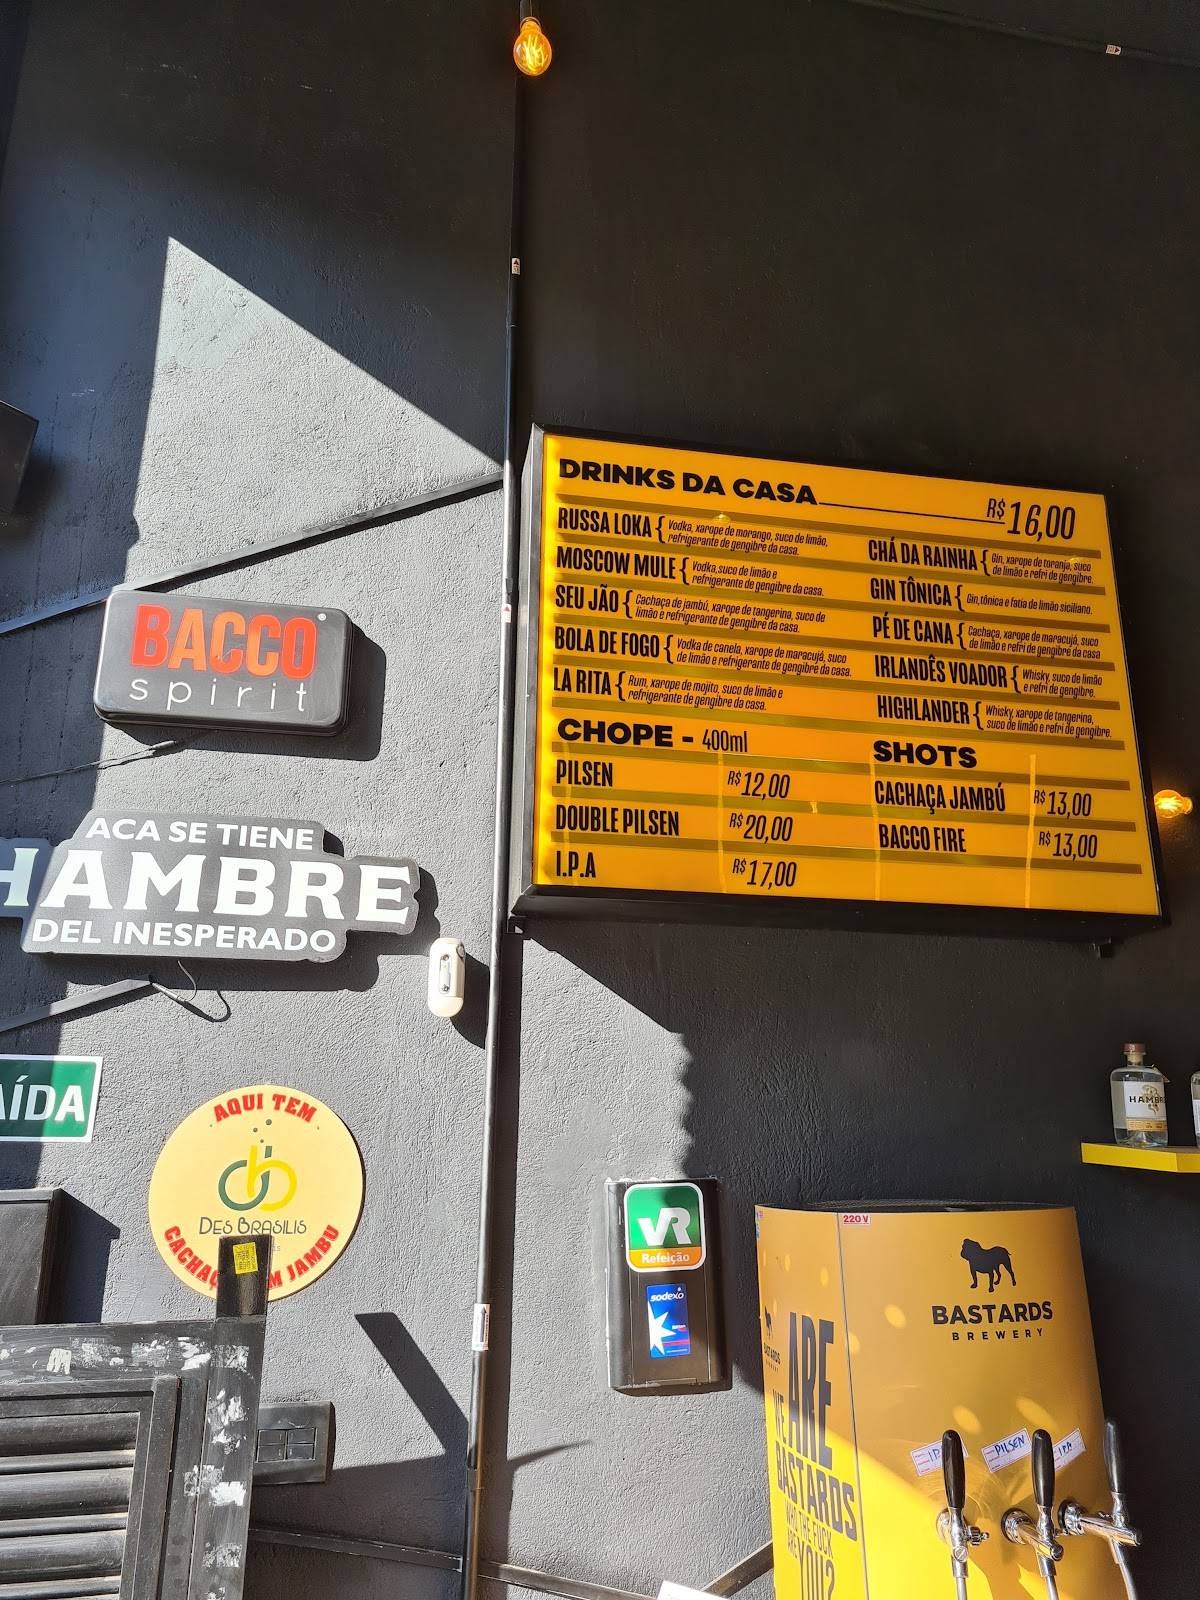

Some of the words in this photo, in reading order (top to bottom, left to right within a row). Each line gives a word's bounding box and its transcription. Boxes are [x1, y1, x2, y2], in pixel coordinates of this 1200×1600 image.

[559, 458, 675, 490] DRINKS
[682, 471, 726, 496] DA
[732, 478, 818, 506] CASA
[557, 507, 611, 534] RUSSA
[614, 512, 652, 538] LOKA
[668, 519, 692, 532] Vodka,
[694, 524, 724, 538] xarope
[724, 525, 735, 537] de
[735, 528, 773, 542] morango,
[774, 532, 794, 543] suco
[794, 532, 805, 544] de
[805, 533, 827, 546] limão,
[667, 532, 719, 548] refrigerante
[730, 540, 767, 554] gengibre
[778, 545, 798, 555] casa.
[868, 536, 898, 563] CHÁ
[900, 542, 921, 566] DA
[922, 544, 978, 571] RAINHA
[556, 545, 631, 575] MOSCOW
[633, 553, 676, 580] MULE
[749, 566, 772, 579] limão
[991, 552, 1005, 565] Gin,
[1005, 556, 1032, 568] xarope
[1043, 559, 1072, 572] toranja,
[1073, 562, 1092, 572] suco
[1003, 565, 1023, 578] limão
[1029, 568, 1048, 580] refri
[1058, 570, 1092, 586] gengibre.
[555, 584, 585, 610] SEU
[587, 583, 619, 613] JÃO
[691, 573, 744, 589] refrigerante
[754, 581, 792, 595] gengibre
[803, 586, 823, 596] casa.
[870, 577, 896, 601] GIN
[898, 575, 952, 607] TÔNICA
[635, 593, 671, 609] Cachaça
[681, 599, 709, 611] jambú,
[711, 603, 741, 615] xarope
[752, 606, 792, 620] tangerina,
[795, 611, 815, 622] suco
[635, 606, 658, 619] limão
[665, 609, 718, 626] refrigerante
[729, 613, 767, 632] gengibre
[778, 622, 799, 633] casa.
[1010, 596, 1028, 609] fatia
[1038, 599, 1059, 612] limão
[1060, 602, 1091, 615] siciliano.
[130, 604, 318, 680] BACCO
[554, 625, 595, 653] BOLA
[598, 629, 618, 655] DE
[621, 631, 660, 659] FOGO
[872, 611, 891, 639] PÉ
[893, 617, 911, 641] DE
[913, 619, 954, 645] CANA
[968, 625, 1002, 640] Cachaça,
[1003, 630, 1031, 643] xarope
[1041, 634, 1078, 647] maracujá,
[1080, 637, 1099, 647] suco
[677, 637, 702, 651] Vodka
[713, 642, 741, 655] canela,
[744, 646, 774, 658] xarope
[785, 650, 824, 663] maracujá,
[827, 653, 847, 664] suco
[979, 638, 1001, 651] limão
[1007, 641, 1026, 653] refri
[1036, 645, 1072, 659] gengibre
[1082, 649, 1101, 659] casa
[688, 651, 711, 665] limão
[717, 654, 771, 671] refrigerante
[781, 661, 819, 676] gengibre
[831, 666, 850, 677] casa.
[874, 653, 946, 683] IRLANDÊS
[948, 661, 1008, 688] VOADOR
[1022, 668, 1051, 684] Whisky,
[1052, 673, 1071, 683] suco
[1082, 673, 1103, 685] limão
[129, 678, 307, 712] spirit
[553, 667, 572, 693] LA
[575, 668, 612, 696] RITA
[628, 674, 647, 688] Rum,
[649, 679, 681, 692] xarope
[693, 682, 719, 694] mojito,
[722, 684, 742, 696] suco
[754, 685, 777, 698] limão
[1029, 682, 1048, 694] refri
[1059, 686, 1094, 700] gengibre.
[627, 688, 682, 705] refrigerante
[693, 693, 733, 710] gengibre
[745, 700, 765, 711] casa.
[877, 694, 970, 725] HIGHLANDER
[986, 704, 1014, 721] Whisky,
[1015, 709, 1043, 723] xarope
[1054, 711, 1094, 726] tangerina,
[986, 719, 1006, 730] suco
[1017, 720, 1039, 732] limão
[1045, 722, 1064, 734] refri
[1075, 725, 1110, 740] gengibre.
[557, 718, 674, 748] CHOPE
[702, 728, 748, 753] 400ml
[873, 739, 978, 769] SHOTS
[555, 759, 613, 788] PILSEN
[874, 780, 947, 815] CACHAÇA
[949, 781, 1006, 812] JAMBÚ
[86, 818, 161, 842] ACA
[168, 821, 206, 843] SE
[216, 823, 314, 851] TIENE
[555, 804, 619, 833] DOUBLE
[622, 808, 680, 837] PILSEN
[878, 823, 931, 851] BACCO
[933, 826, 967, 853] FIRE
[555, 850, 597, 879] I.P.A
[31, 919, 103, 943] DEL
[112, 922, 336, 953] INESPERADO
[0, 1074, 85, 1121] ÍDA
[213, 1093, 264, 1123] AQUI
[272, 1093, 318, 1122] TEM
[636, 1207, 692, 1246] VR
[843, 1215, 861, 1223] 220
[862, 1215, 869, 1223] V
[164, 1225, 219, 1291] CACHAÇ
[287, 1224, 340, 1282] JAMBU
[641, 1251, 690, 1266] Refeição
[650, 1291, 685, 1302] sodexo
[931, 1301, 1054, 1325] BASTARDS
[952, 1328, 1043, 1341] BREWERY
[788, 1312, 835, 1471] ARE
[994, 1434, 1026, 1456] PILSEN
[1058, 1441, 1073, 1457] IPA
[775, 1440, 858, 1543] BASTARDS
[812, 1521, 834, 1560] FUCK
[797, 1535, 836, 1600] YOU?
